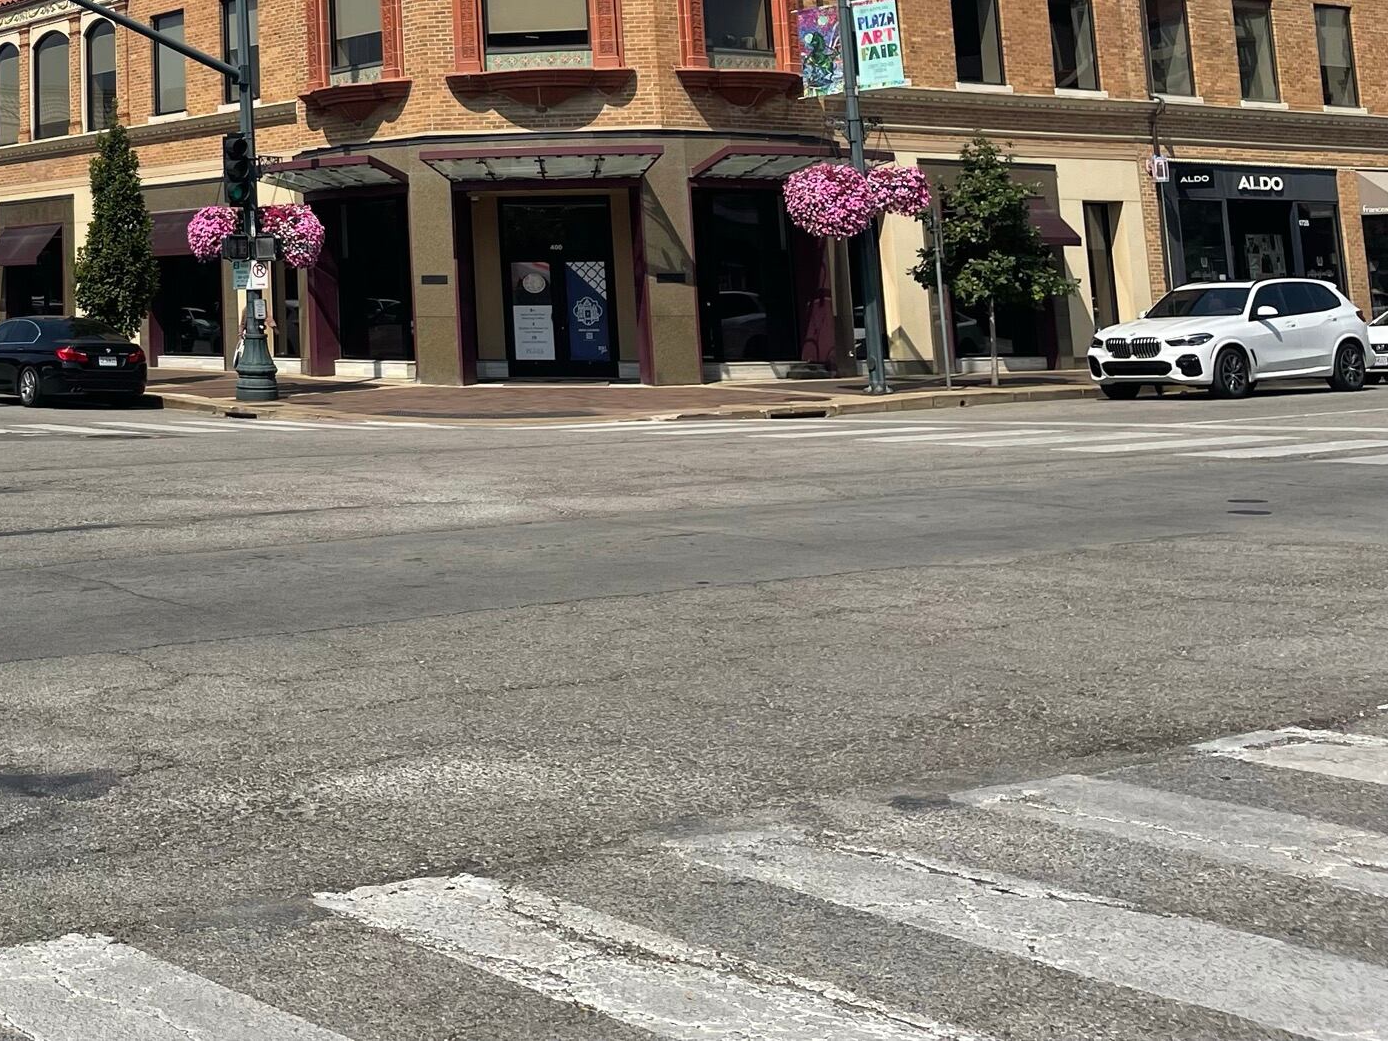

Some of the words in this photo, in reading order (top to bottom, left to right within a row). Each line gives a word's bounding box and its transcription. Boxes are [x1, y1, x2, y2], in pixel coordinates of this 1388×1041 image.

[857, 12, 895, 30] PLAZA
[860, 27, 896, 46] ART
[861, 43, 899, 61] FAIR
[1180, 175, 1210, 183] ALDO
[1238, 176, 1284, 190] ALDO
